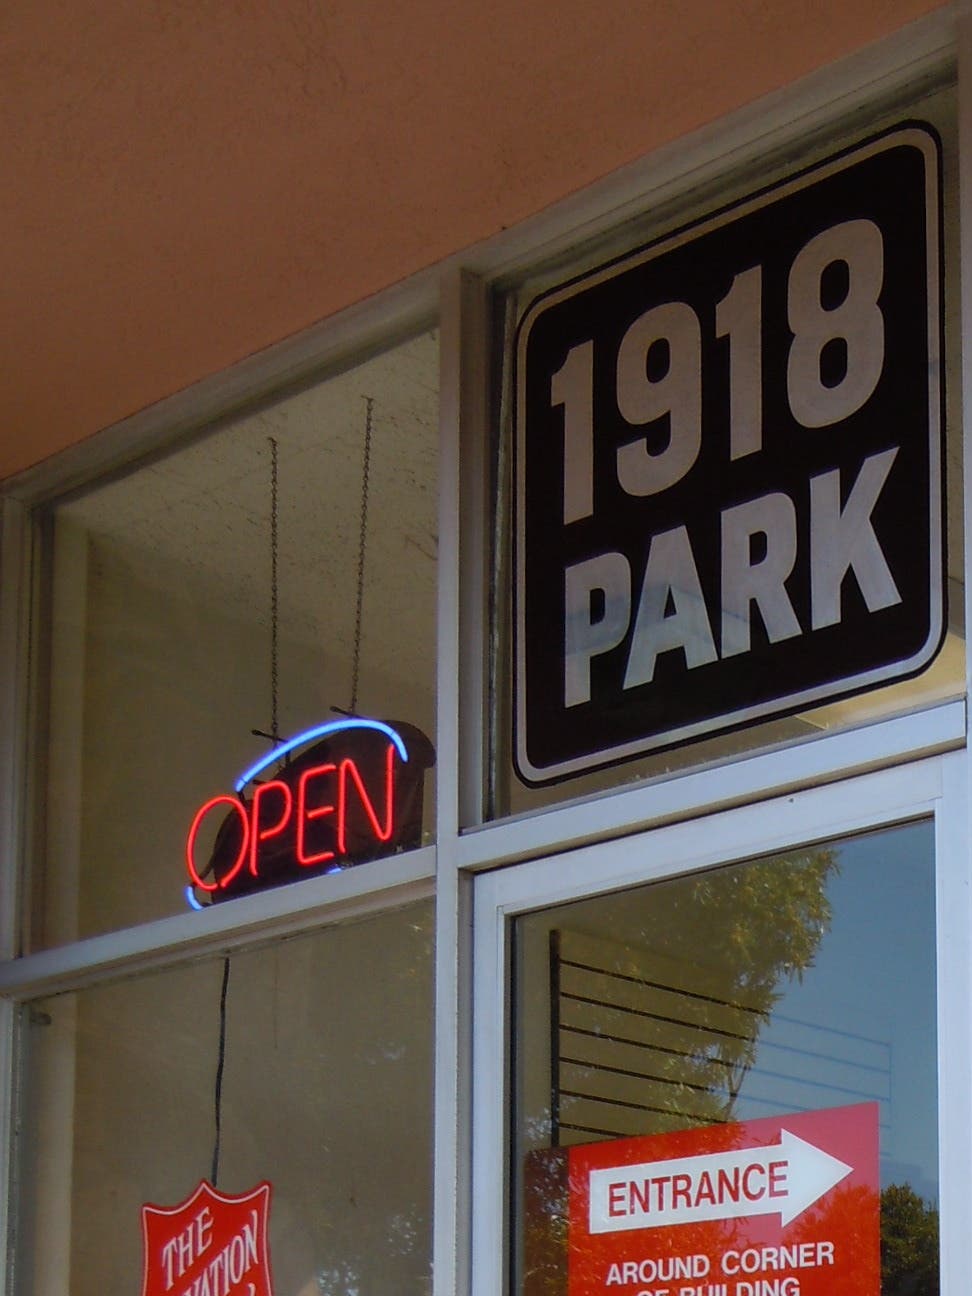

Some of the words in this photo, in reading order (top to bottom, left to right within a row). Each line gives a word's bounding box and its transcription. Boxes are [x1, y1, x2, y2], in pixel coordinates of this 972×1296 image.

[551, 219, 884, 525] 1918
[565, 447, 902, 709] PARK
[187, 744, 396, 890] OPEN
[608, 1160, 789, 1218] ENTRANCE
[161, 1206, 214, 1291] THE
[605, 1254, 711, 1286] AROUND
[721, 1241, 835, 1275] CORNER
